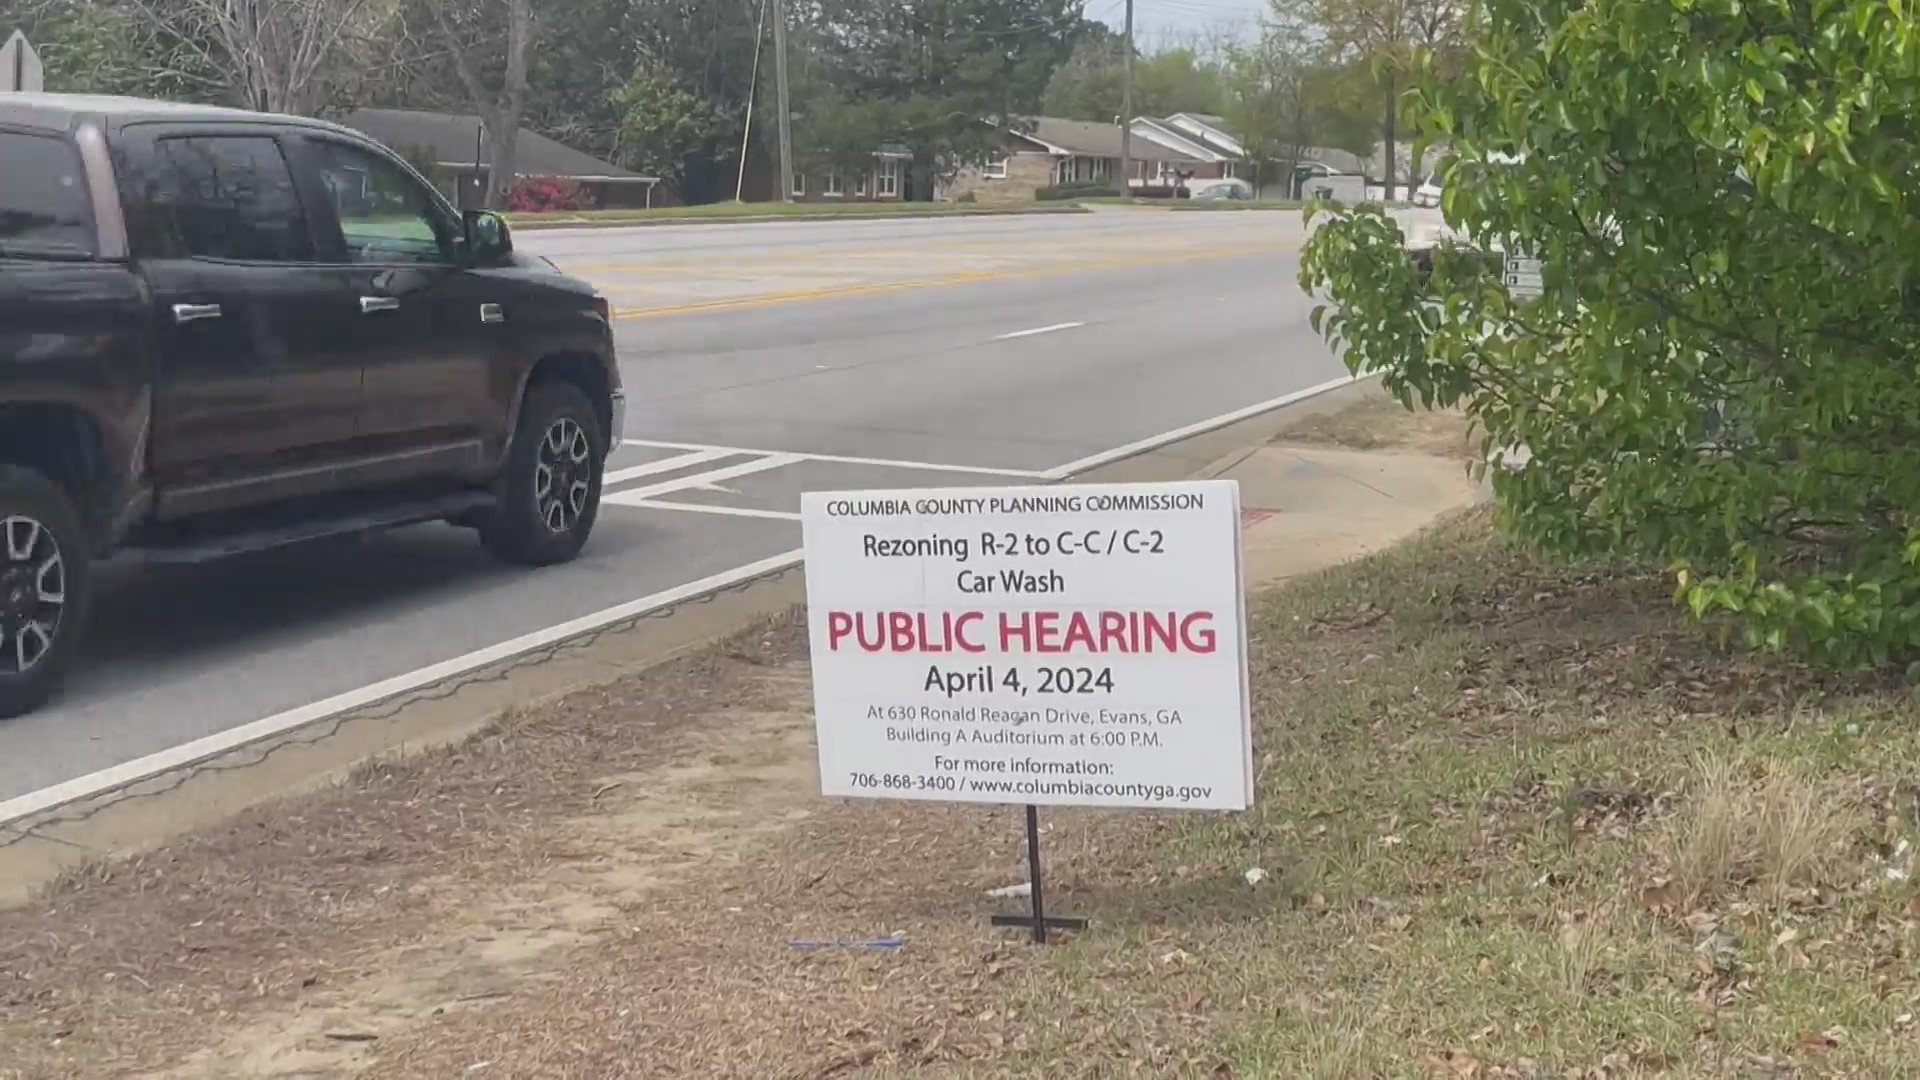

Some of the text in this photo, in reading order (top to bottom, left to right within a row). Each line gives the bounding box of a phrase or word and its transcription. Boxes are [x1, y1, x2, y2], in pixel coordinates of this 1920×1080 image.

[827, 494, 1204, 516] COLUMBIA COUNTY PLANNING COMMISSION
[864, 529, 1165, 562] Rezoning R-2 to C-C / C-2
[957, 568, 1065, 593] Car Wash
[828, 611, 1216, 654] PUBLIC HEARING
[924, 665, 1115, 698] April 4, 2024
[867, 705, 1183, 726] At 630 Ronald Reagan Drive, Evans, GA
[886, 727, 1163, 747] Building A Auditorium at 6:00 P.M.
[935, 755, 1114, 775] For more information:
[850, 772, 1212, 801] 706-868-3400 / www.columbiacountyga.gov
